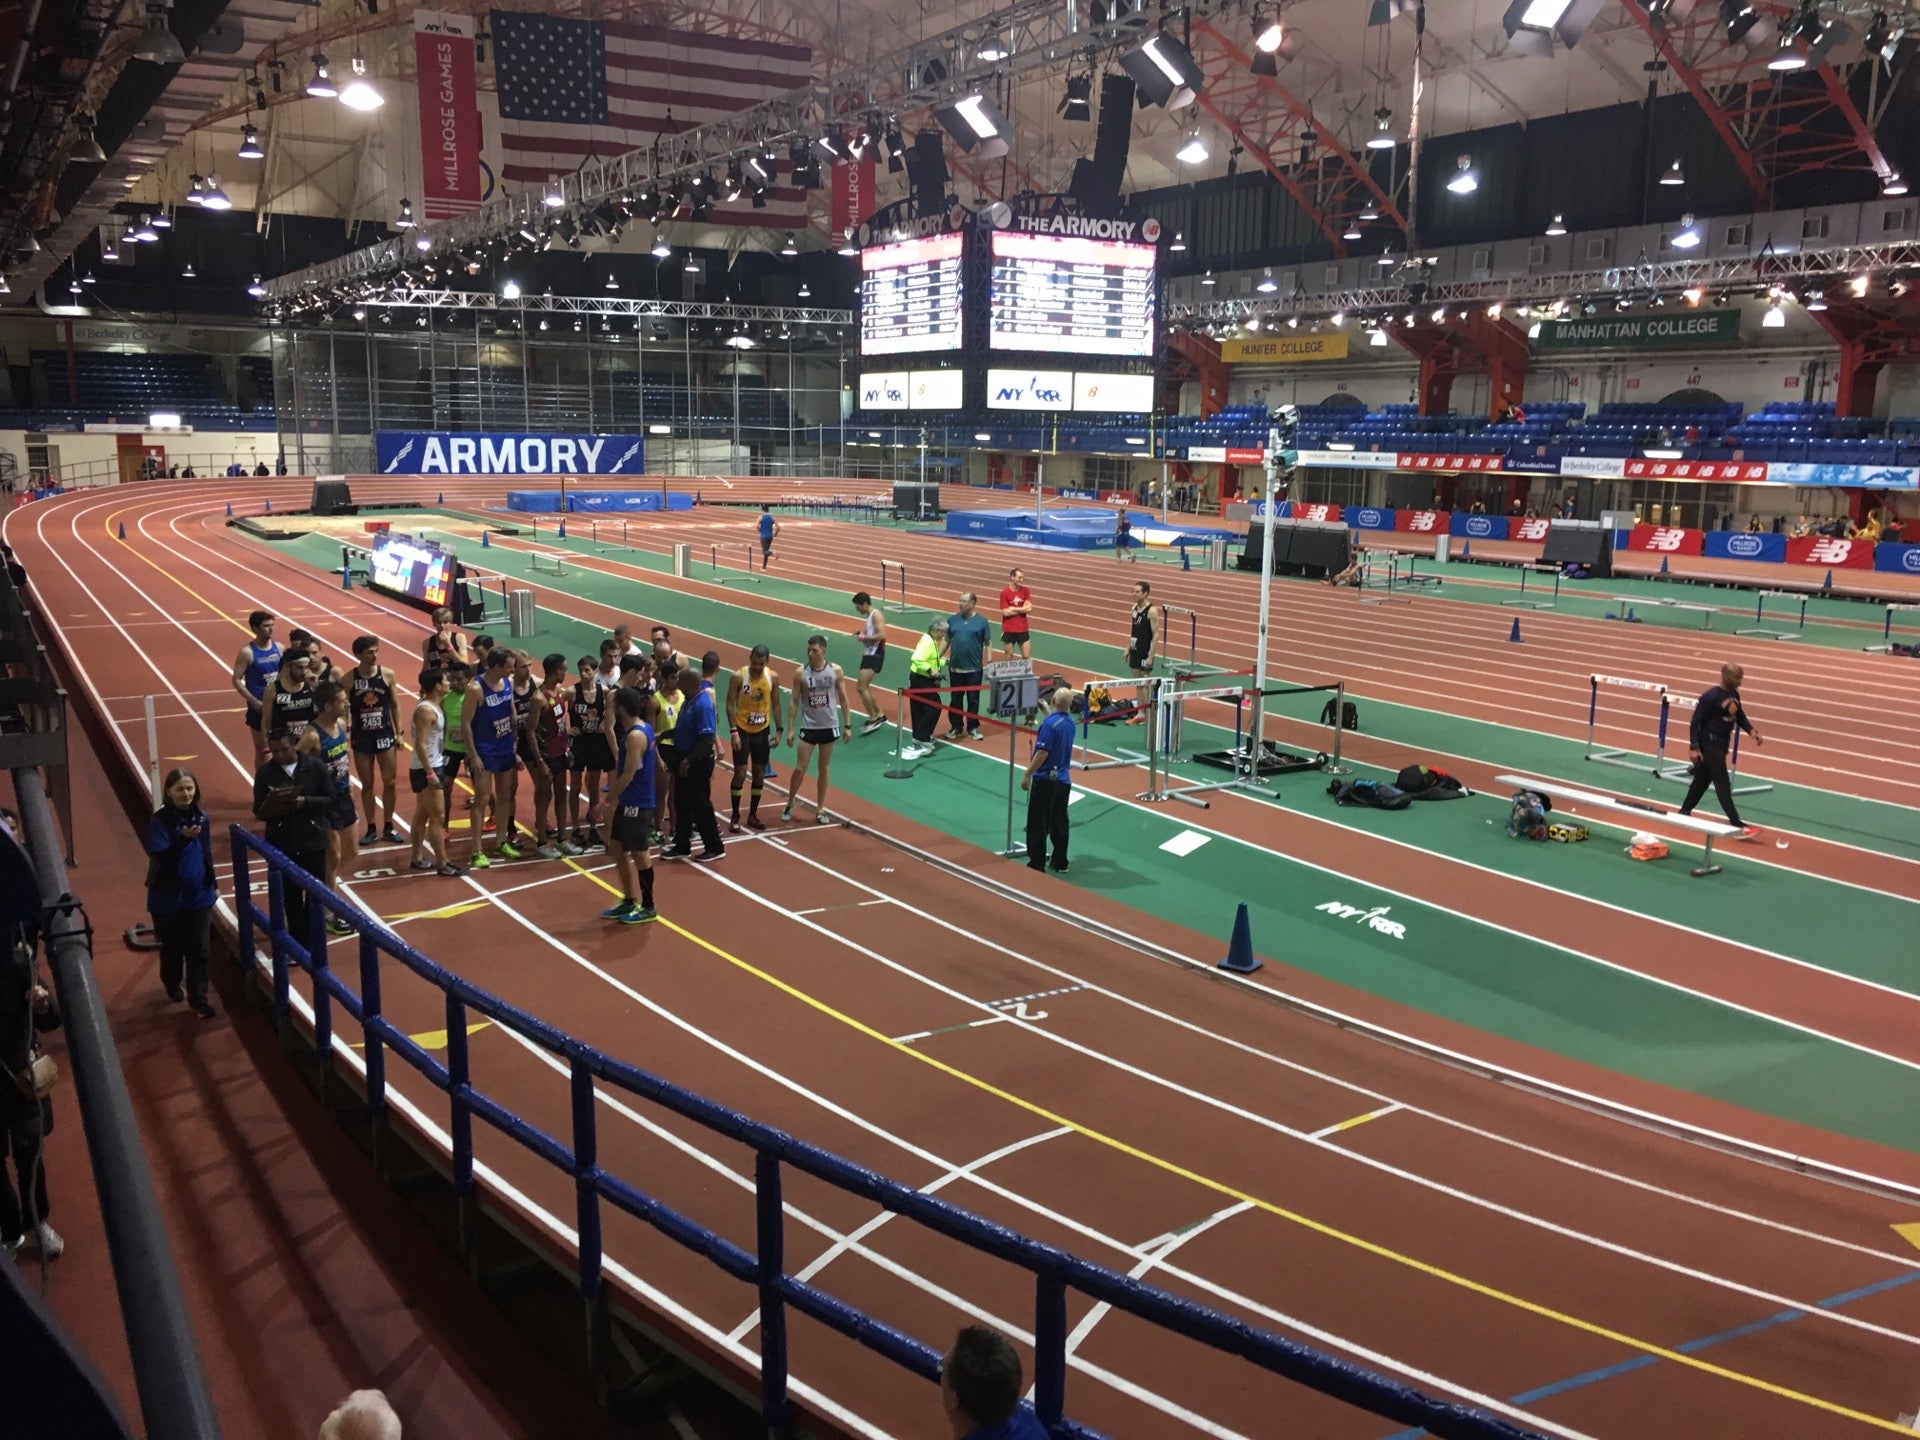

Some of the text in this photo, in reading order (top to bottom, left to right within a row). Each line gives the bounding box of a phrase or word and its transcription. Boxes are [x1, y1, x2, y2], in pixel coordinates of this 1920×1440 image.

[437, 42, 459, 191] MILLROSE GAMES
[892, 212, 945, 241] ARMORY
[1018, 214, 1136, 240] THE ARMORY
[87, 328, 130, 341] Berkeley
[1556, 317, 1718, 339] MANHATTAN COLLEGE
[1241, 340, 1324, 355] HUNTER COLLEGE
[1686, 374, 1701, 386] 447
[421, 436, 605, 474] ARMORY
[1570, 461, 1622, 474] Berkeley College
[743, 684, 751, 694] 2
[362, 717, 382, 728] 2453
[998, 1002, 1048, 1020] 2
